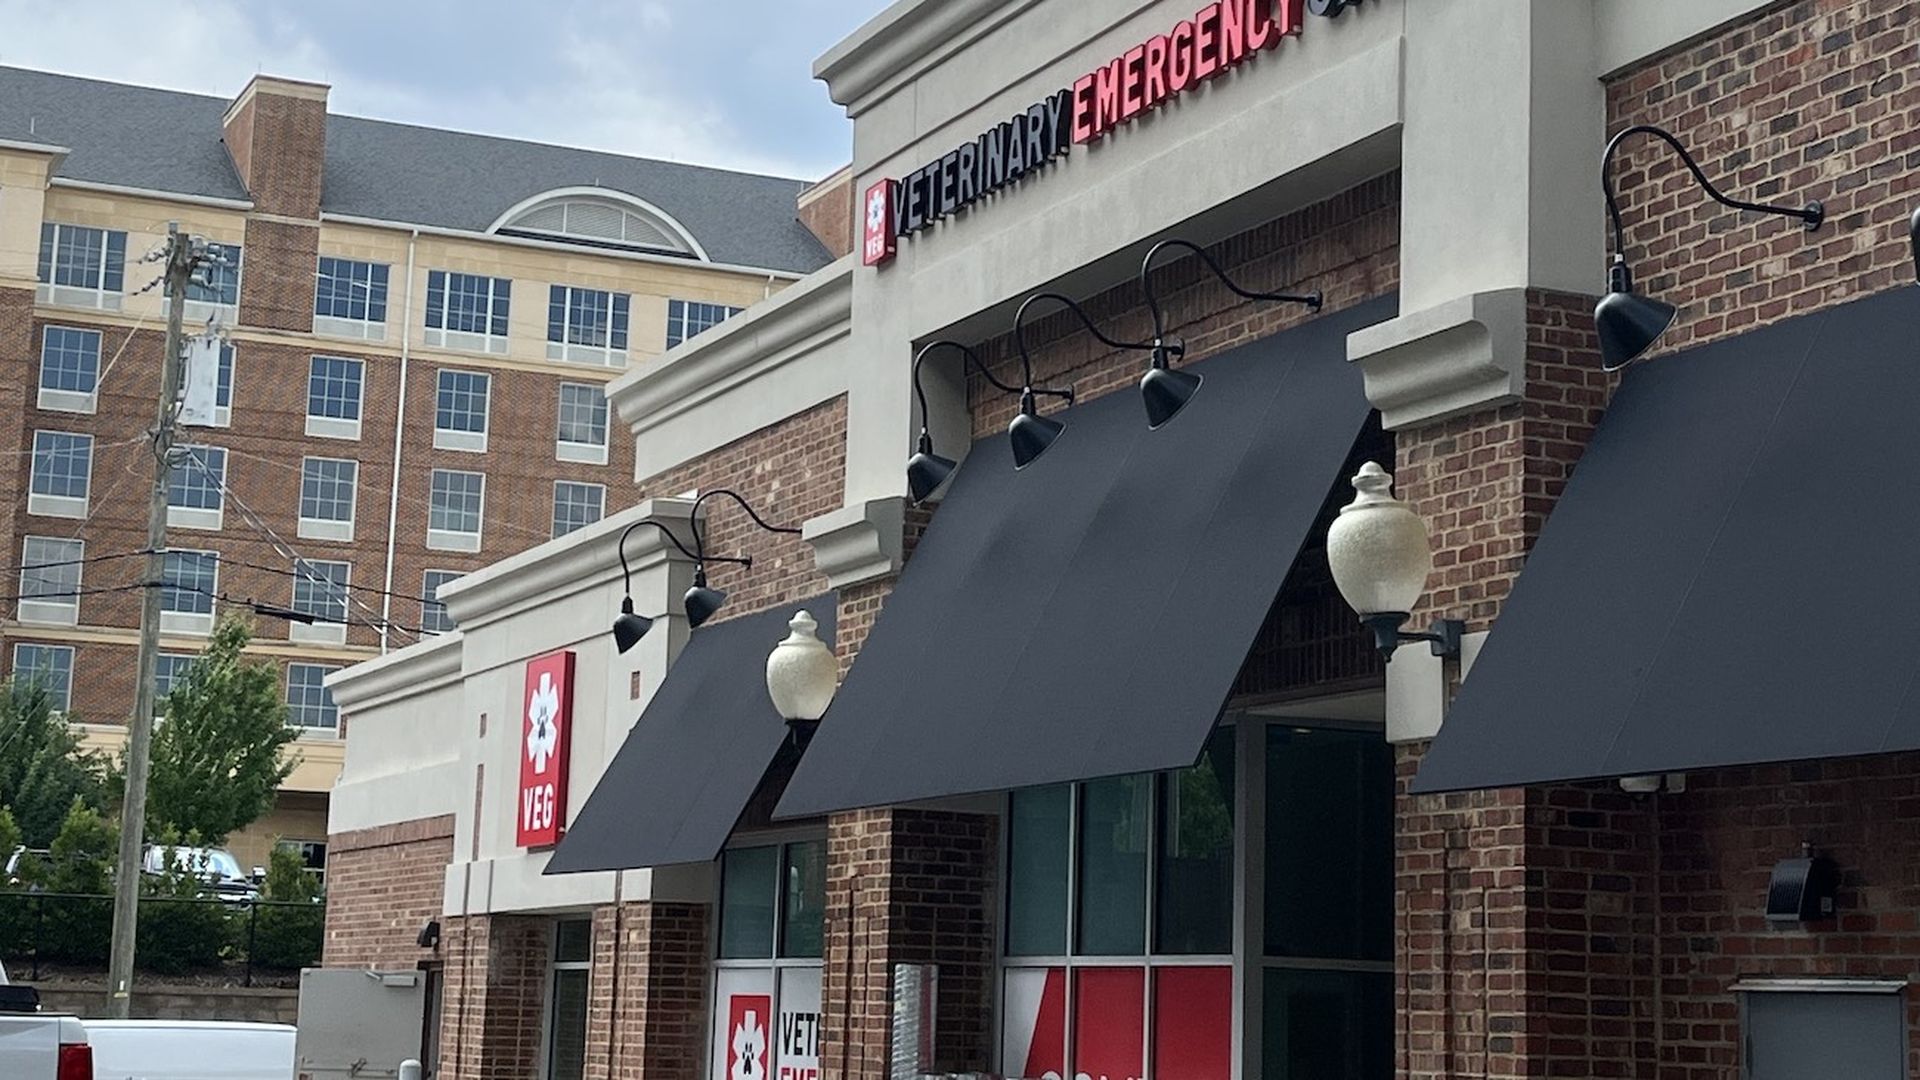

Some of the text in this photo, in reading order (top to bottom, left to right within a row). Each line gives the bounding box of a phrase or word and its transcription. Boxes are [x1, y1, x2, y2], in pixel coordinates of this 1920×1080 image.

[892, 90, 1066, 236] VETERINARY
[865, 232, 886, 258] VEG
[523, 783, 555, 832] VEG
